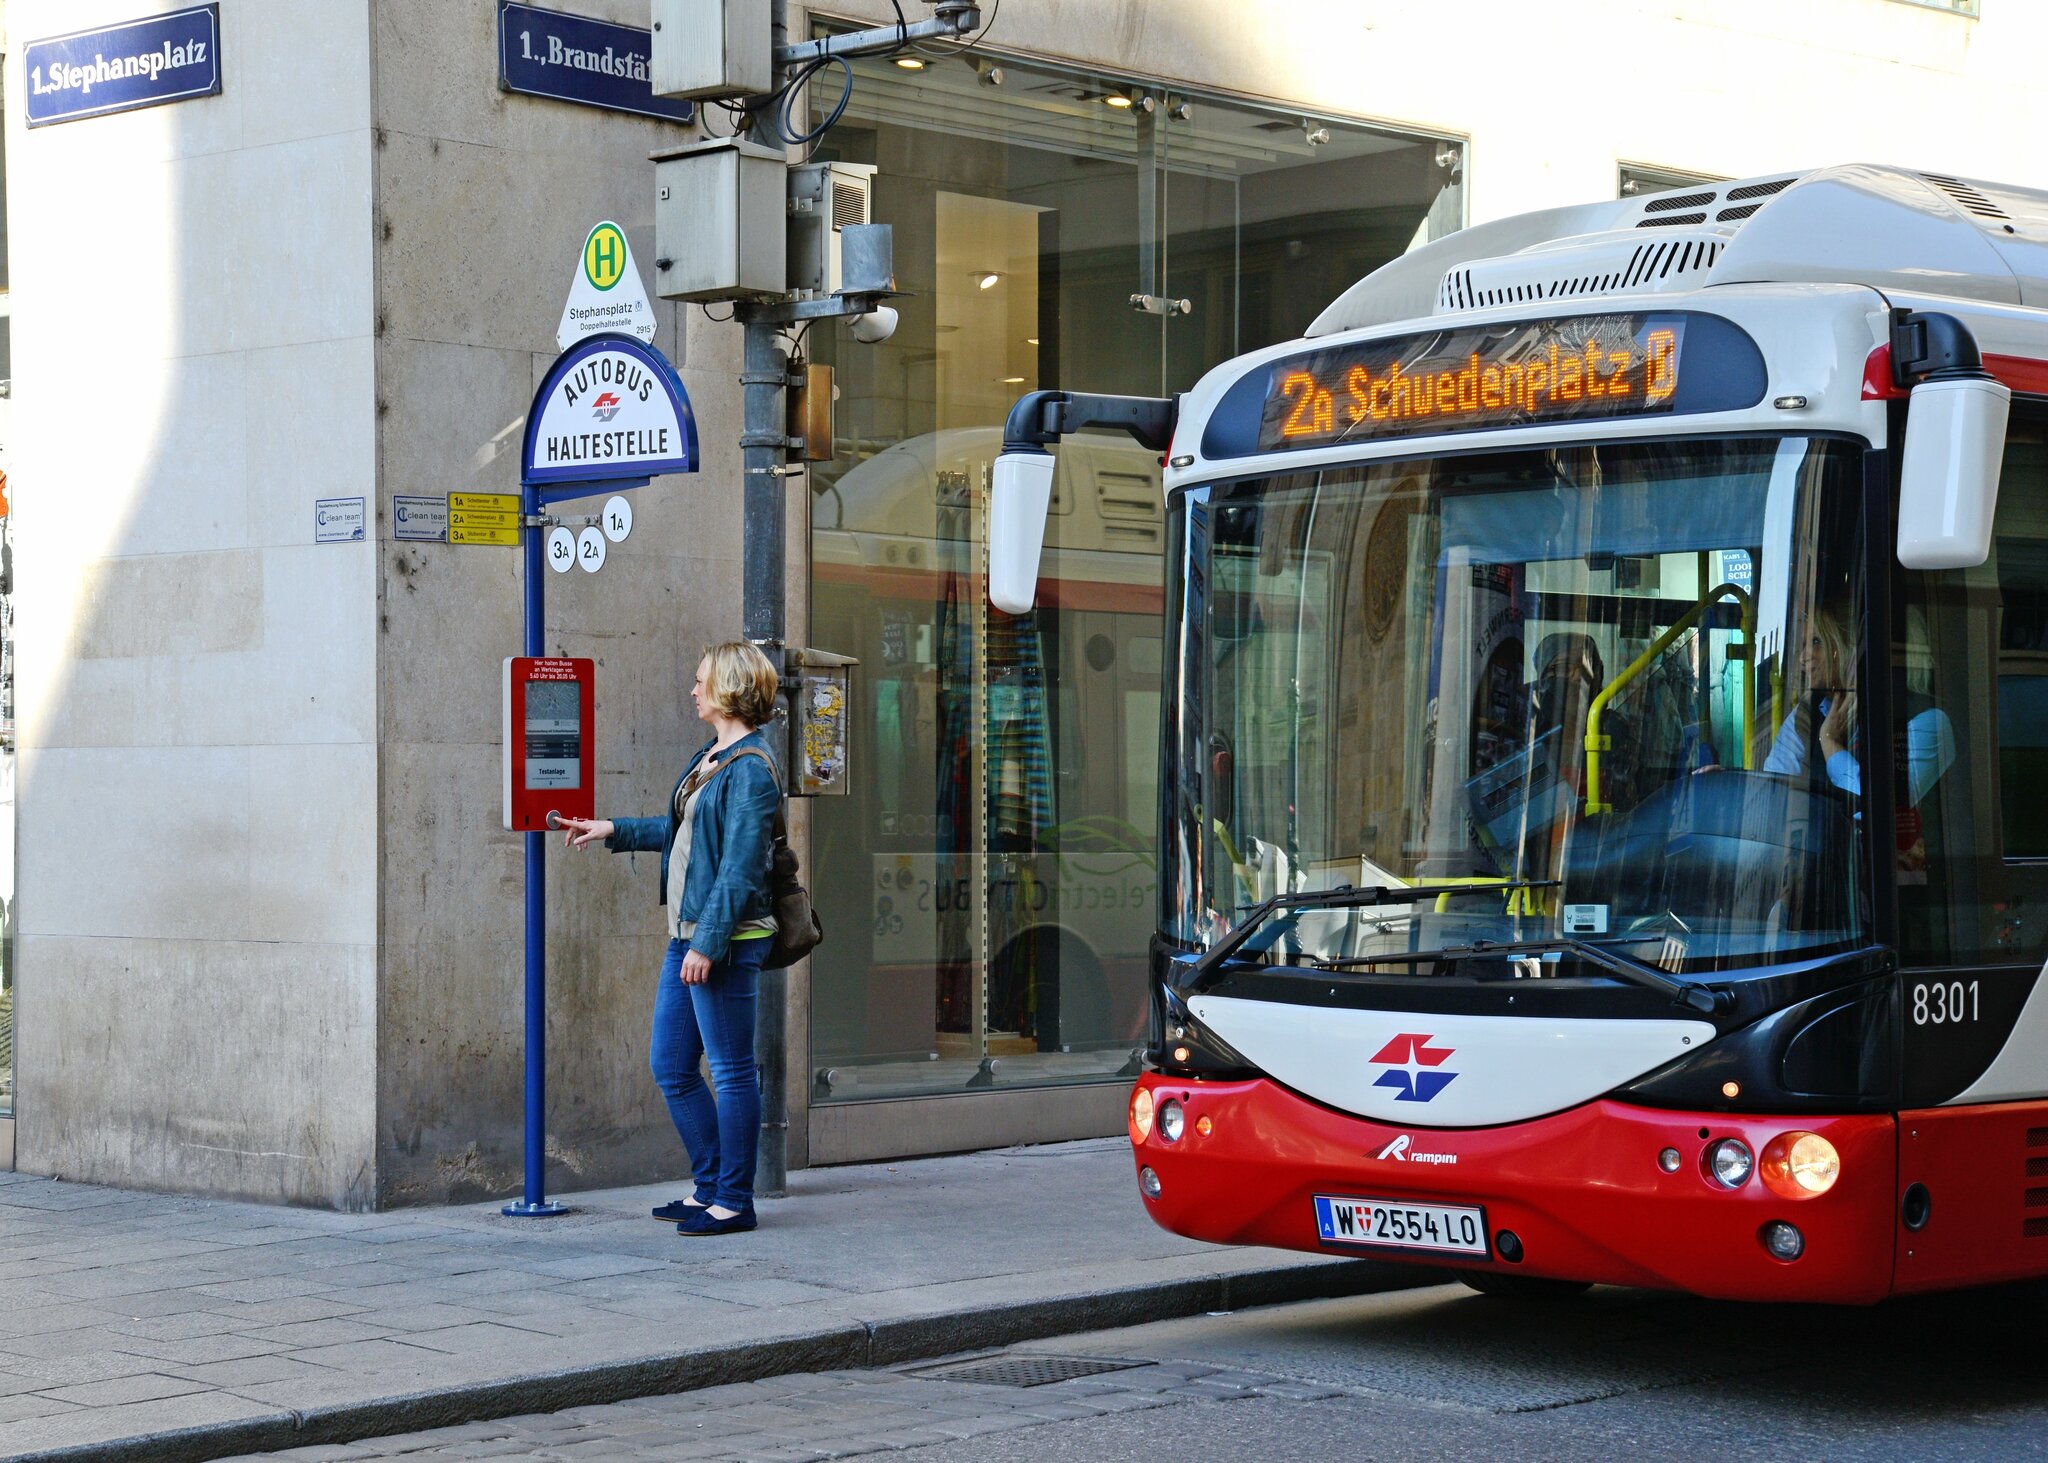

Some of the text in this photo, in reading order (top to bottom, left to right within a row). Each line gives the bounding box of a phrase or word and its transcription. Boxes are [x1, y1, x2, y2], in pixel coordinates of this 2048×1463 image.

[595, 237, 615, 278] H
[570, 303, 632, 320] Stephansplatz
[580, 318, 632, 331] Doppelhaltestelle
[636, 326, 651, 334] 2915
[564, 358, 652, 407] AUTOBUS
[1284, 338, 1630, 435] 2A Schwedenplatz
[548, 428, 668, 462] HALTESTELLE
[454, 497, 464, 506] 1A
[407, 512, 429, 520] clean
[453, 514, 464, 523] 2A
[610, 513, 624, 531] 1A
[453, 531, 464, 540] 3A
[554, 541, 569, 559] 3A
[583, 540, 599, 558] 2A
[1913, 980, 1979, 1025] 8301
[1411, 1152, 1457, 1166] rampini
[1324, 1223, 1331, 1232] A
[1335, 1204, 1354, 1235] W
